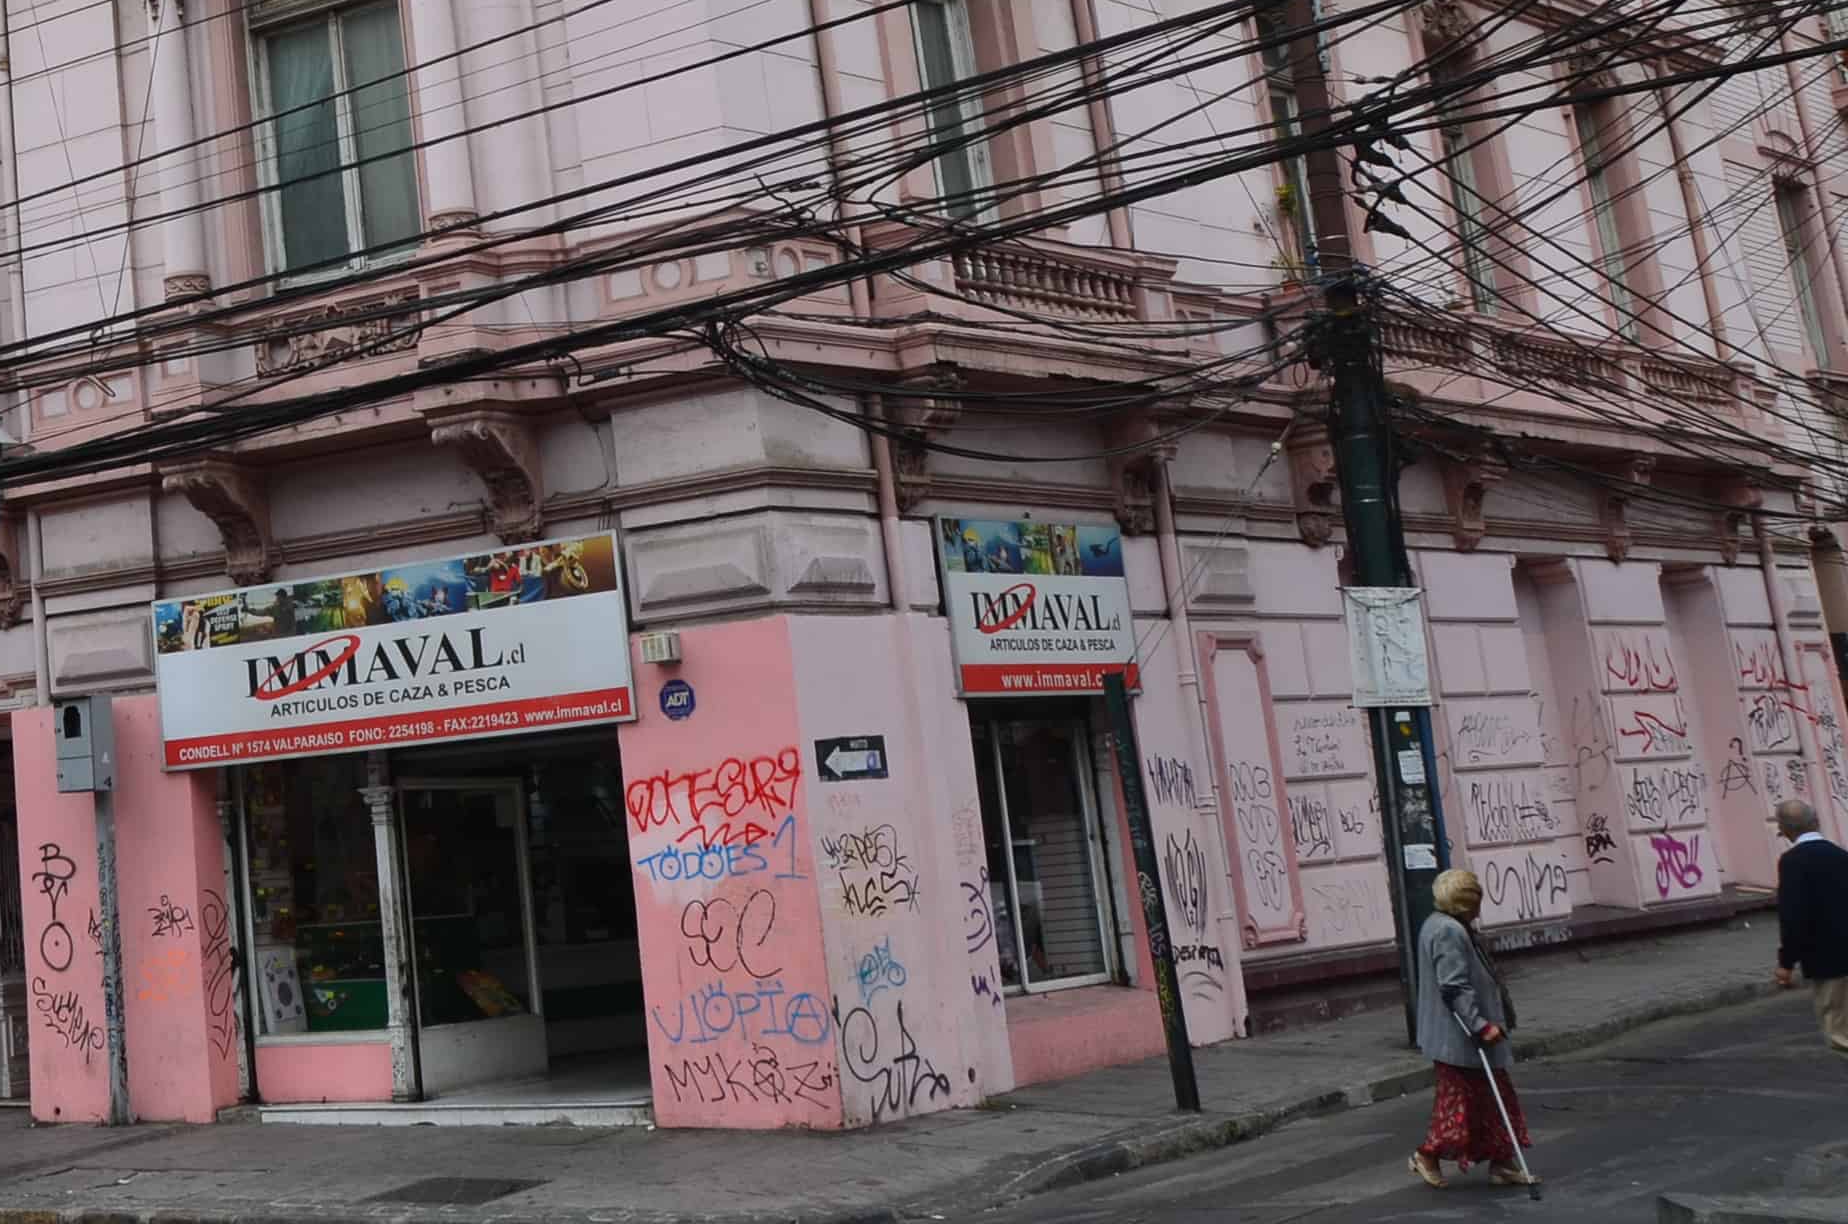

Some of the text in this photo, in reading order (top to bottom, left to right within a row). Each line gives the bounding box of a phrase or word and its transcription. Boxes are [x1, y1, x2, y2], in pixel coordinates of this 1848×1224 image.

[990, 639, 1115, 651] ARTICULOS DE CAZA & PESCA
[1002, 669, 1106, 688] www.immaval.c
[270, 675, 511, 718] ARTICULOS DE CAZA & PESCA
[665, 691, 689, 707] ADT
[179, 743, 230, 761] CONDELL
[247, 739, 271, 754] 1574
[272, 731, 344, 752] VALPARAISO
[348, 726, 387, 742] FONO:
[388, 721, 434, 739] 2254198
[443, 711, 519, 733] FAX:2219423
[524, 698, 622, 723] www.immaval.cl
